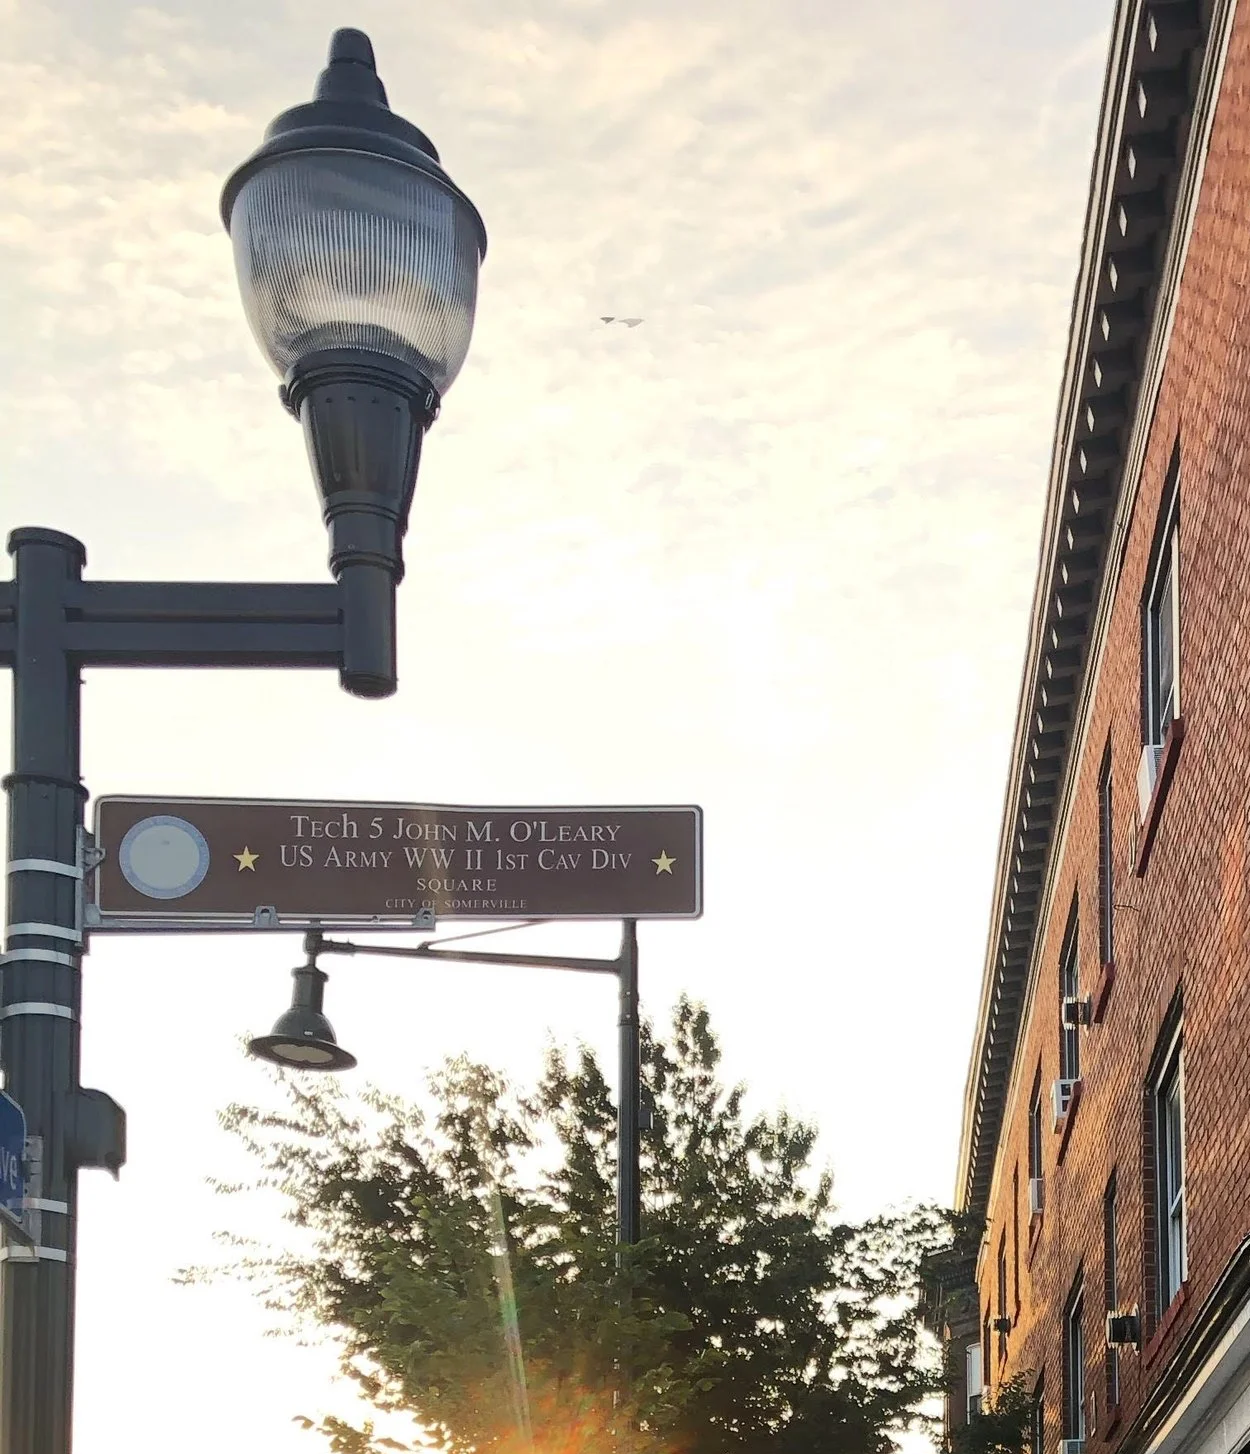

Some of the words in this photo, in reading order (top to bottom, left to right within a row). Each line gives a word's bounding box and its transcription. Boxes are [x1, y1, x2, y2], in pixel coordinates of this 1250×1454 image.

[369, 817, 383, 839] 5
[393, 817, 457, 841] JOHN
[465, 821, 500, 842] M.
[509, 821, 622, 842] O'LEARY
[280, 845, 313, 867] US
[324, 846, 392, 868] ARMY
[403, 847, 456, 870] WW
[465, 849, 483, 870] II
[496, 849, 529, 870] 1ST
[538, 848, 582, 870] CAV
[591, 849, 632, 870] DIV
[416, 878, 497, 894] SQUARE
[385, 899, 415, 909] CITY
[421, 899, 437, 909] OF
[445, 899, 528, 909] SOMERVILLE
[0, 1146, 17, 1190] ve
